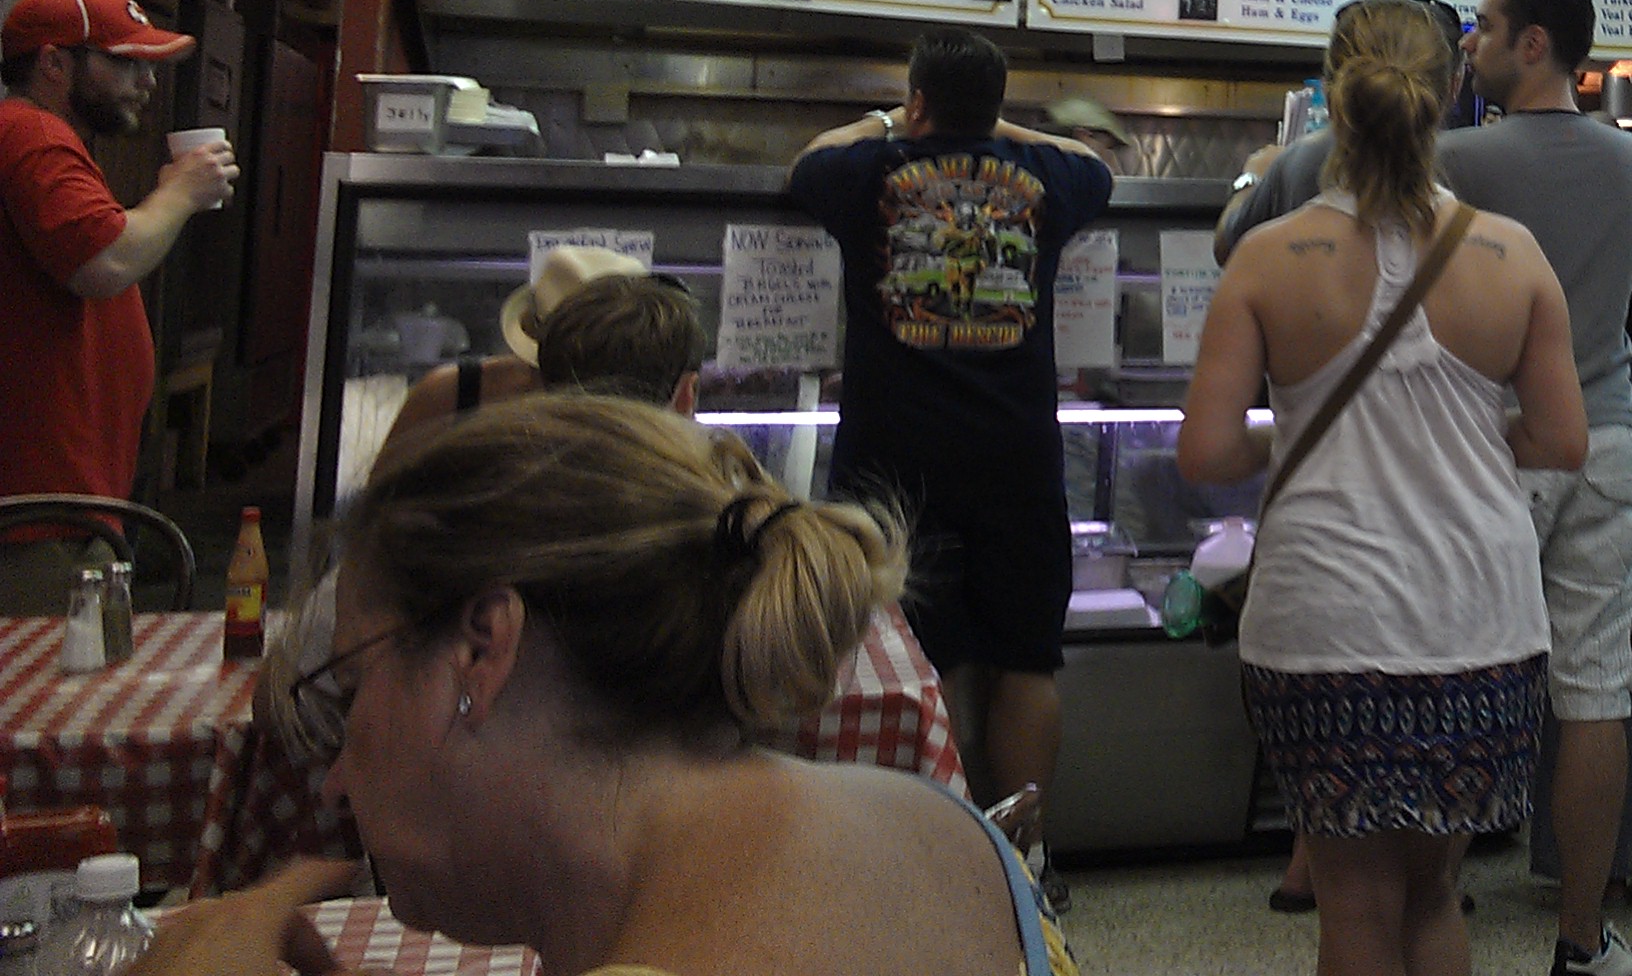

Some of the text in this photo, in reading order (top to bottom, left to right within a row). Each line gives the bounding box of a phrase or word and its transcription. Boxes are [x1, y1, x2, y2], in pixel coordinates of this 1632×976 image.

[1242, 6, 1320, 22] Ham & Eggs
[1601, 8, 1624, 21] Veal
[1601, 24, 1623, 36] Veal
